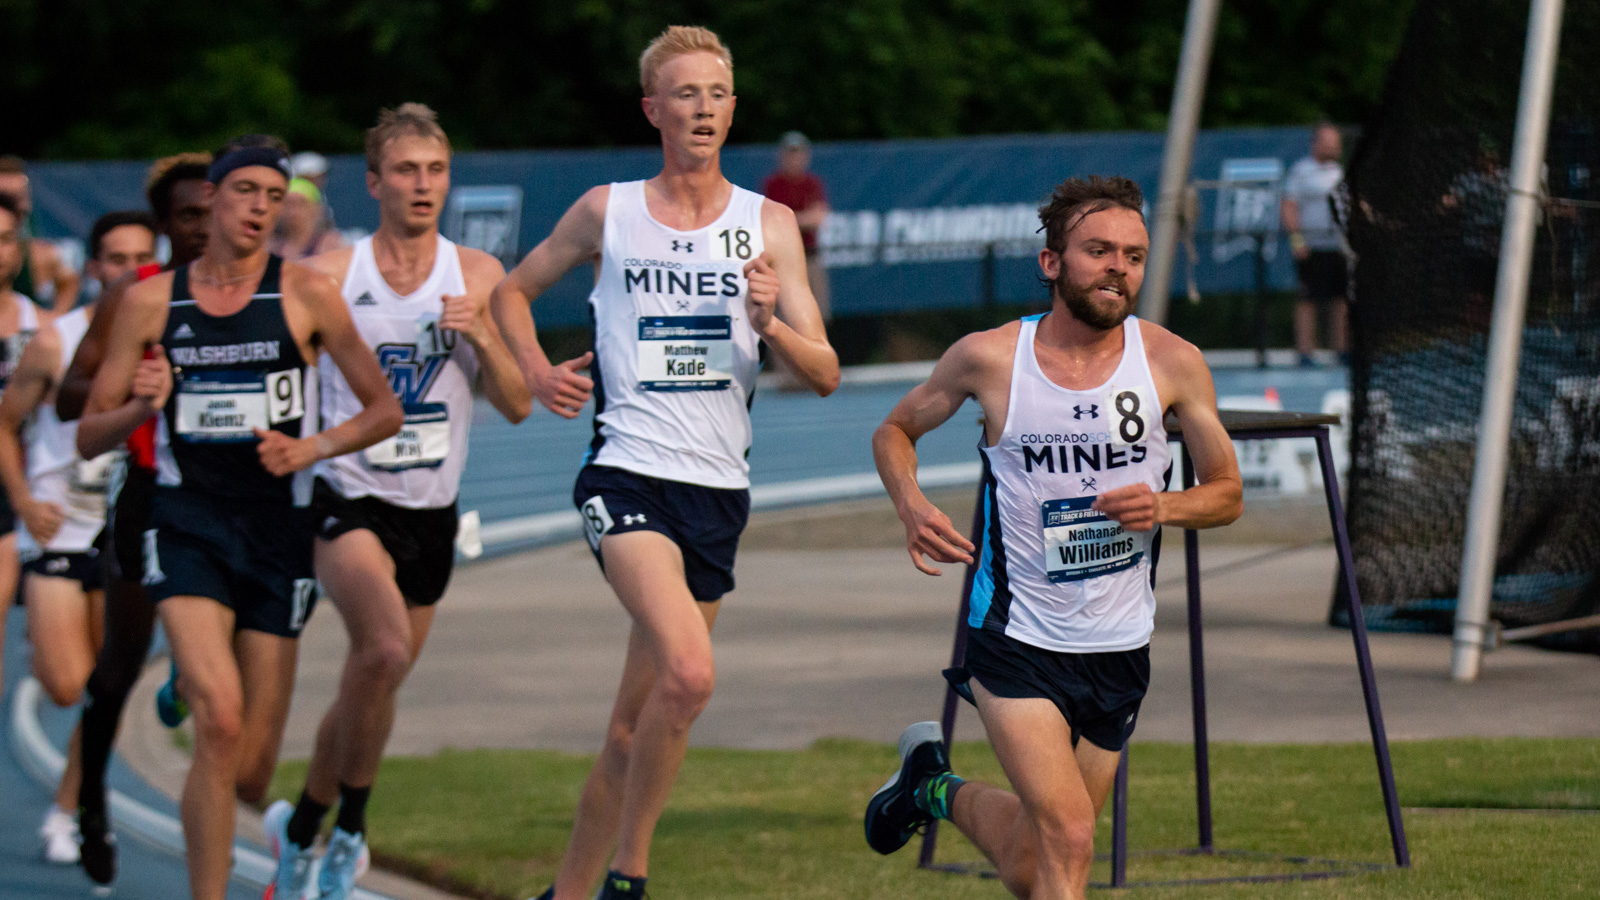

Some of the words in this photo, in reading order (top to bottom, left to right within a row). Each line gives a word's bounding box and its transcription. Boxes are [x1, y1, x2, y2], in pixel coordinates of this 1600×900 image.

[718, 228, 752, 260] 18
[624, 258, 682, 270] COLORADO
[624, 268, 740, 297] MINES
[170, 340, 280, 365] WASHBURN
[664, 345, 709, 356] Matthew
[666, 359, 706, 376] Kade
[275, 374, 293, 417] 9
[1115, 390, 1145, 443] 8
[1020, 433, 1089, 444] COLORADO
[1021, 443, 1148, 474] MINES
[1068, 525, 1125, 542] Nathanae
[1058, 537, 1133, 565] Williams
